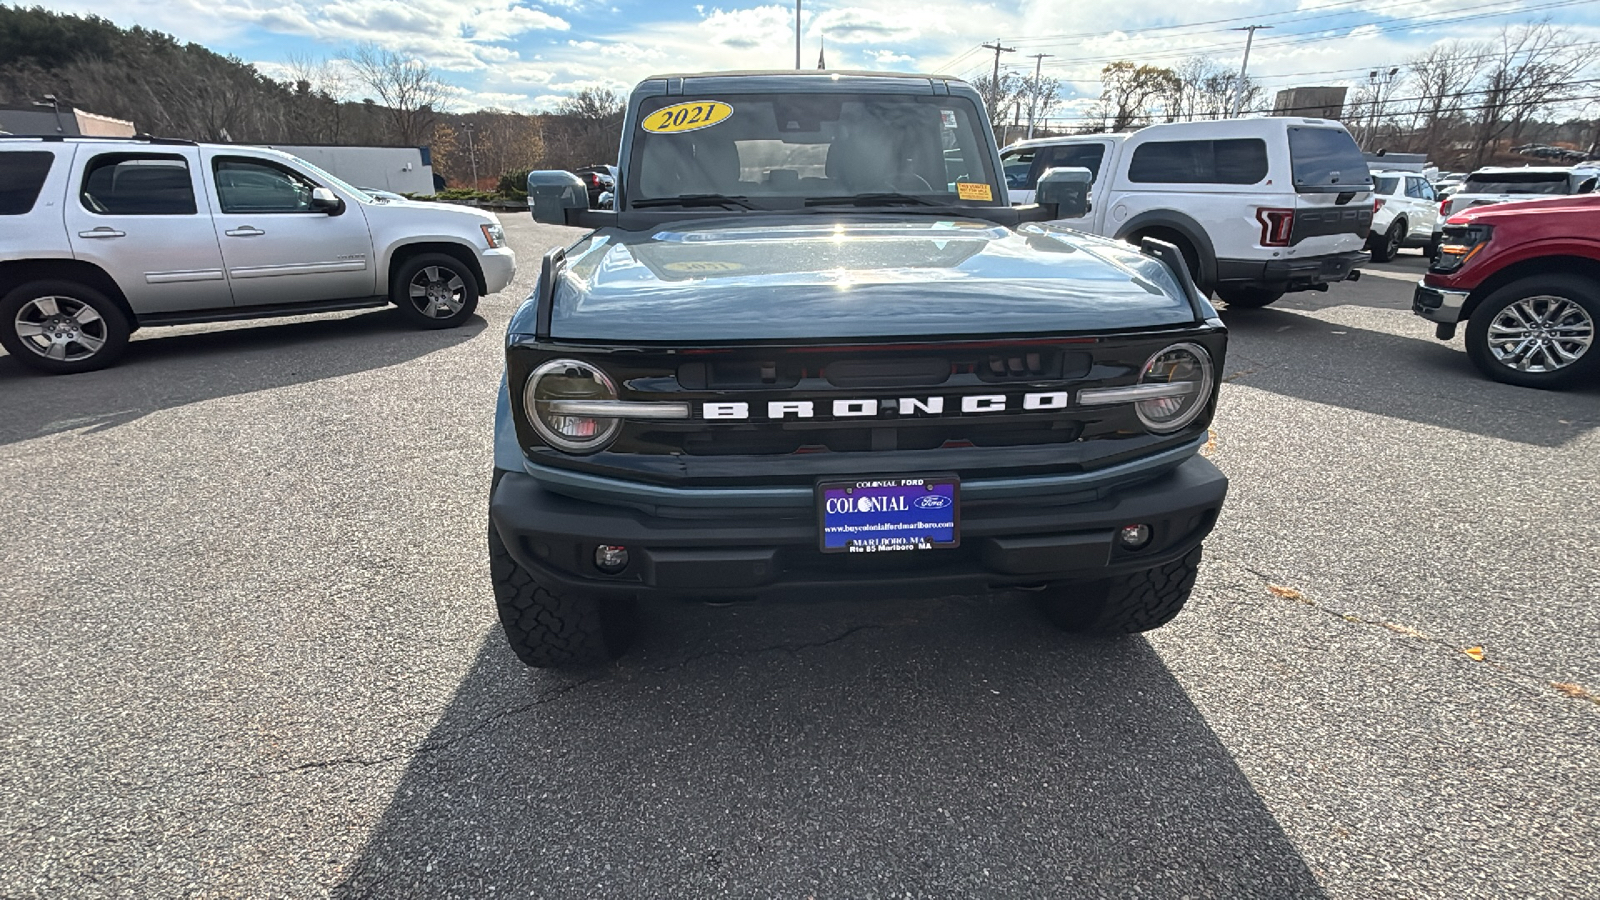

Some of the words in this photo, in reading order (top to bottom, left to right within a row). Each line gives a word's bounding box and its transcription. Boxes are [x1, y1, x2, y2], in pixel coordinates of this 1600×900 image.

[657, 104, 716, 130] 2021
[702, 391, 1068, 419] BRONCO
[856, 480, 897, 488] COLONIAL
[826, 496, 909, 514] COLONIAL
[825, 522, 954, 533] www.buycolonialfordmarlboro.com
[878, 544, 914, 552] Marlboro
